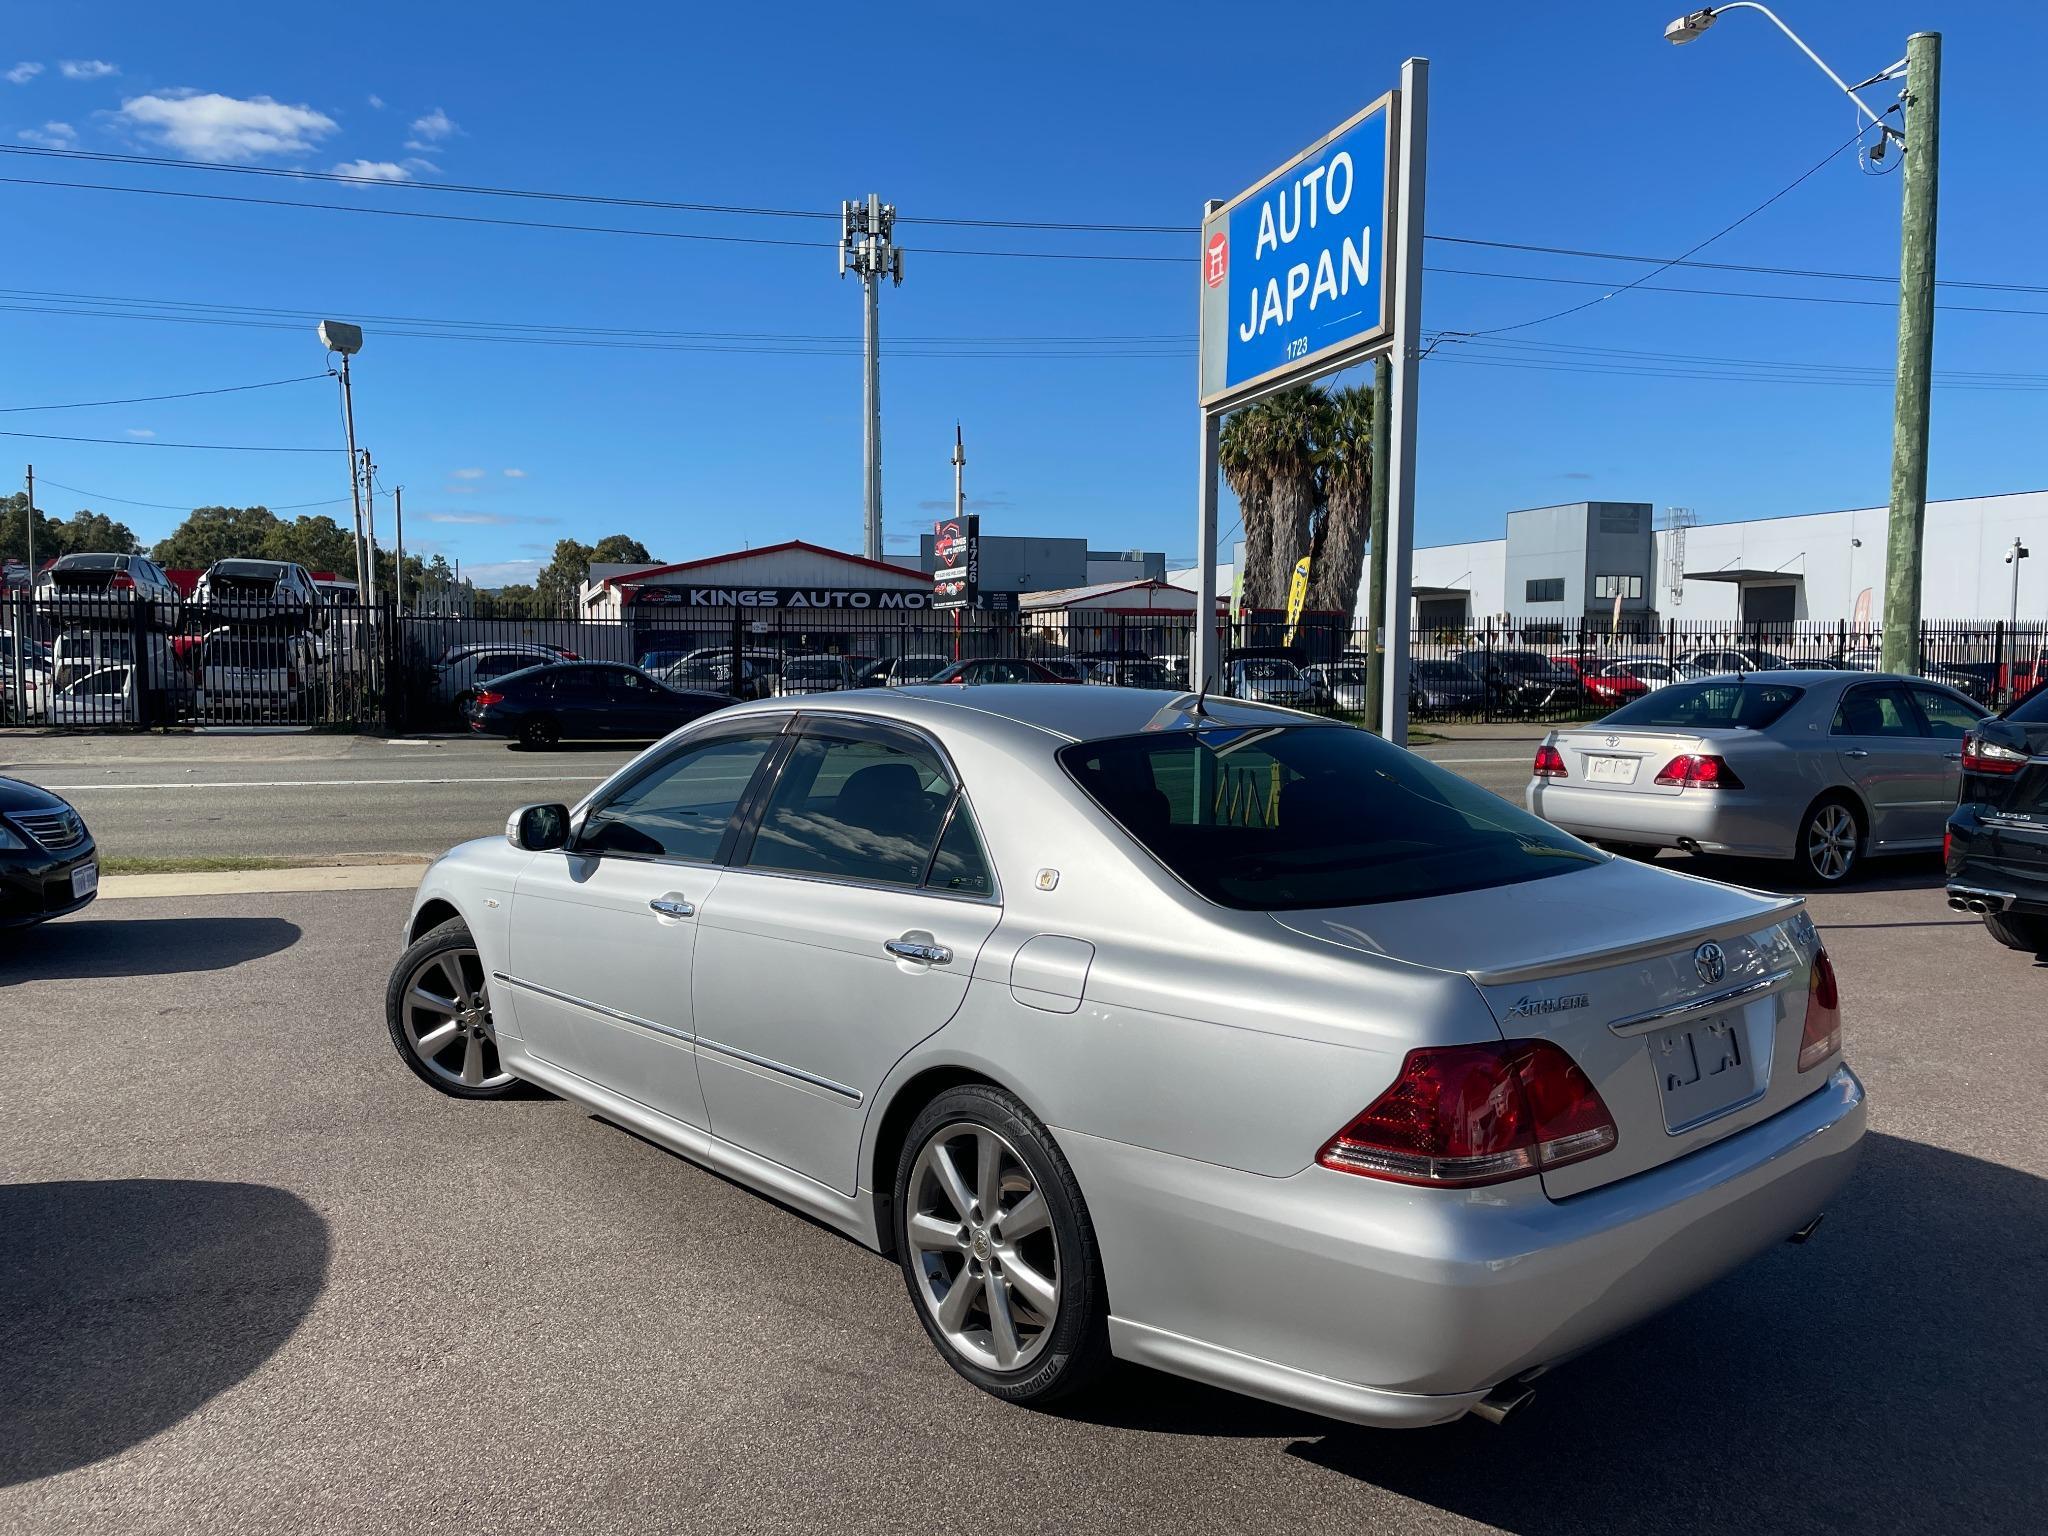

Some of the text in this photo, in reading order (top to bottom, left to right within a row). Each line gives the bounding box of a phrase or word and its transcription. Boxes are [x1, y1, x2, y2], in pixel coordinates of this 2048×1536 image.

[1255, 151, 1353, 260] AUTO
[1240, 225, 1370, 342] JAPAN
[1287, 336, 1308, 360] 1723
[968, 537, 977, 583] 1726
[690, 589, 778, 607] KINGS
[787, 591, 871, 608] AUTO
[1287, 580, 1302, 641] FINAE
